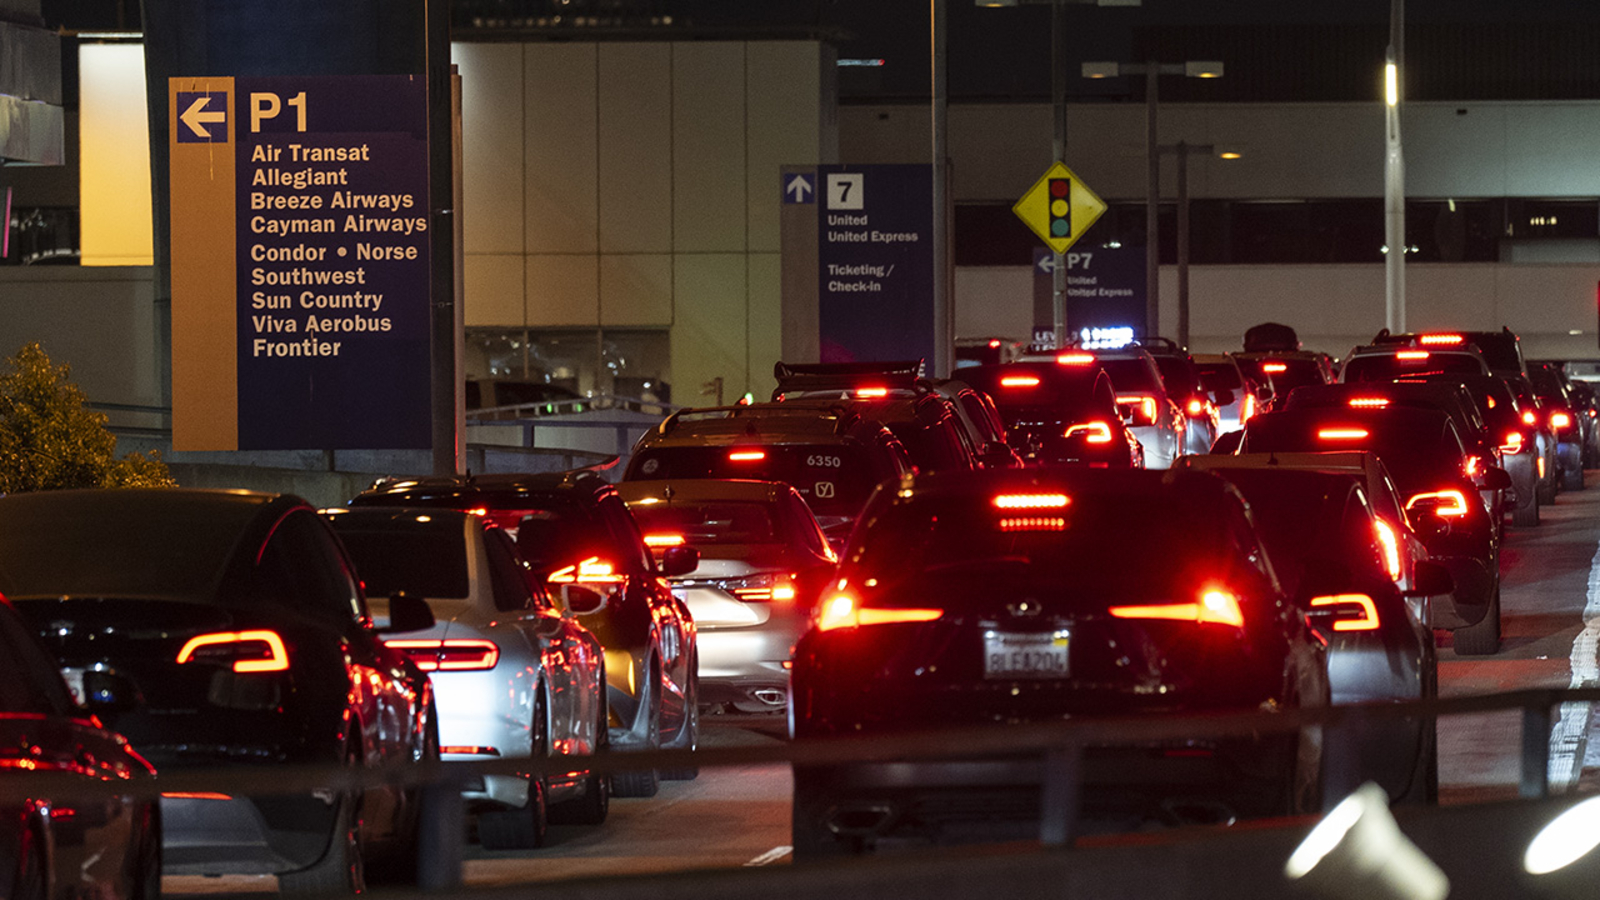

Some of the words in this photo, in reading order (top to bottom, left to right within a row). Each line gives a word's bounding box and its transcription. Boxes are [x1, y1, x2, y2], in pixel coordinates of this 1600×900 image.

[250, 92, 307, 133] P1
[251, 144, 282, 162] Air
[288, 144, 370, 162] Transat
[252, 168, 348, 189] Allegiant
[251, 192, 323, 210] Breeze
[330, 191, 414, 212] Airways
[837, 181, 853, 203] 7
[251, 216, 336, 237] Cayman
[344, 215, 427, 235] Airways
[828, 215, 868, 226] United
[828, 231, 868, 242] United
[871, 230, 918, 243] Express
[251, 244, 327, 262] Condor
[356, 243, 418, 260] Norse
[1067, 253, 1093, 269] P7
[251, 267, 366, 285] Southwest
[828, 264, 885, 277] Ticketing
[251, 291, 292, 310] Sun
[299, 291, 383, 312] Country
[252, 315, 297, 333] Viva
[304, 314, 392, 332] Aerobus
[253, 338, 341, 357] Frontier
[806, 455, 841, 468] 6350
